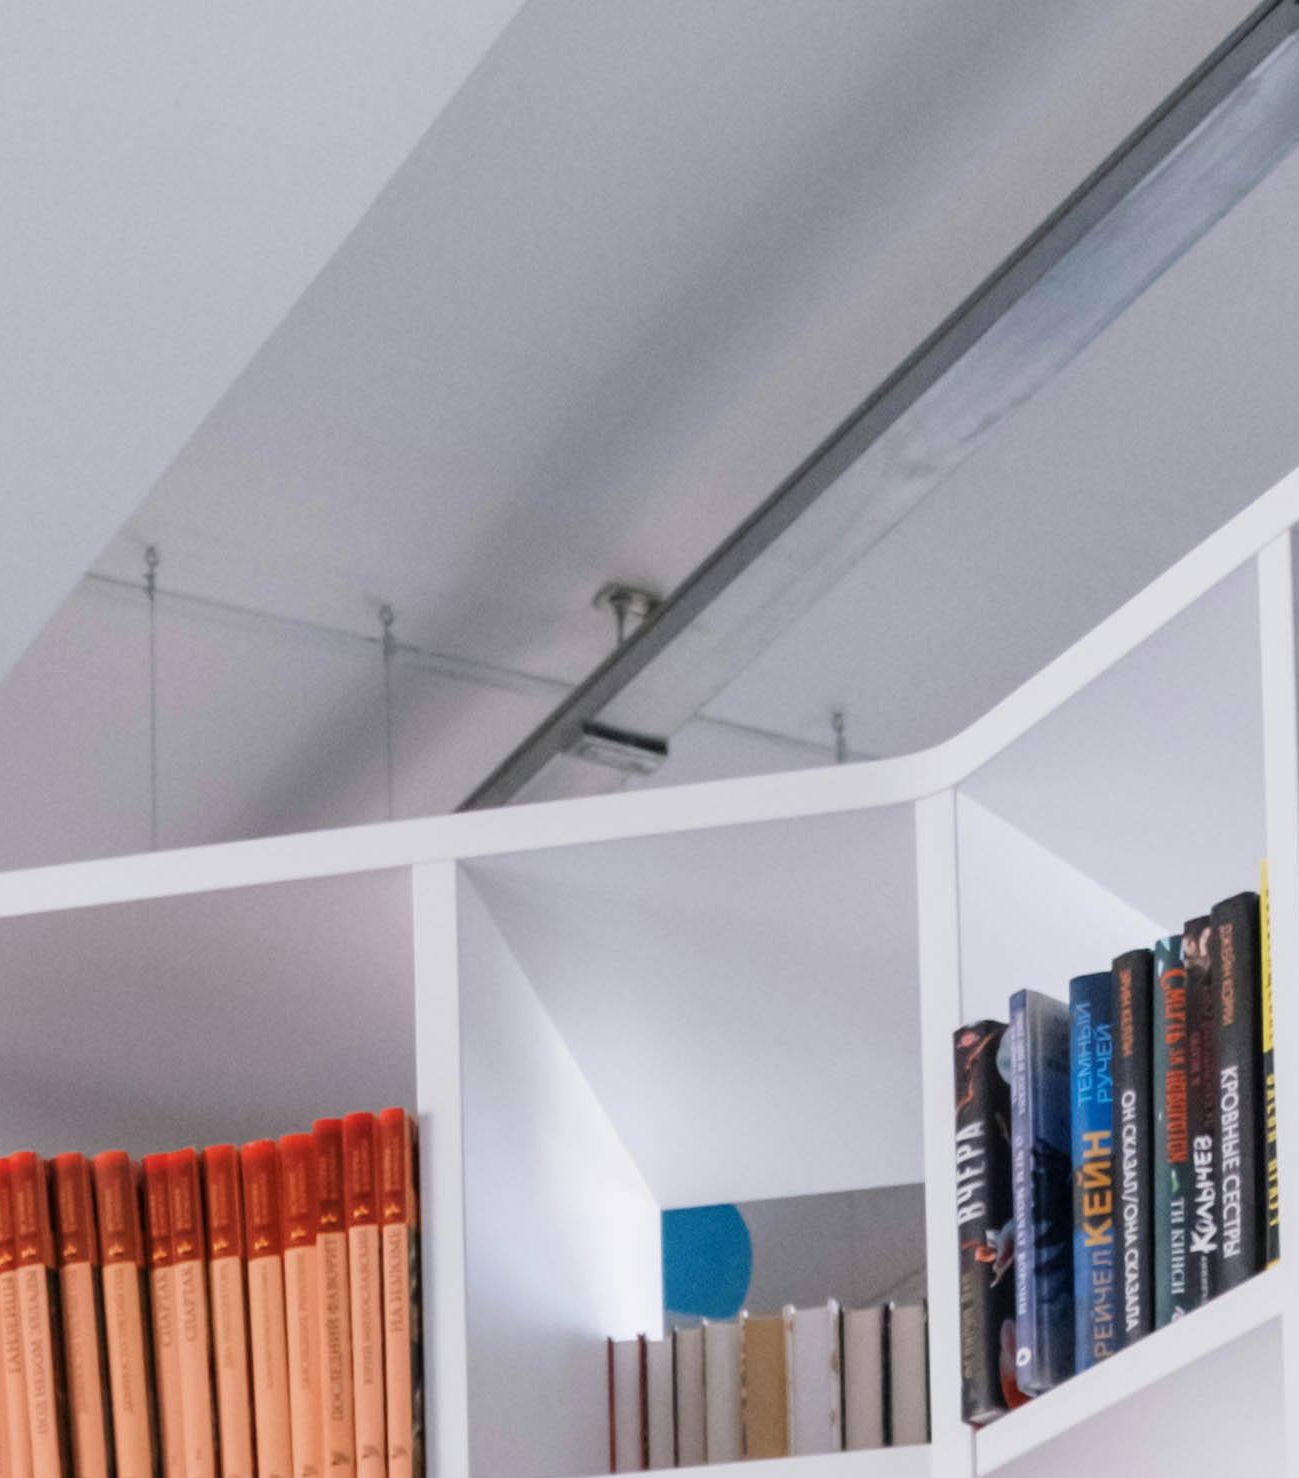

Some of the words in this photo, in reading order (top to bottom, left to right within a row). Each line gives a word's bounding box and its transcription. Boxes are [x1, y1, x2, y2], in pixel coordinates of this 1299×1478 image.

[1074, 1003, 1095, 1106] ТЕМНЫЙ
[1095, 1024, 1115, 1104] РУЧЕЙ
[1120, 1089, 1137, 1118] ОН
[1220, 1066, 1242, 1169] КРОВНЫЕ
[955, 1119, 988, 1229] ВЧЕРА
[1075, 1130, 1114, 1247] КЕЙН
[1220, 1176, 1242, 1260] СЕСТРЫ
[320, 1237, 343, 1315] ФАВОРИТ
[1092, 1249, 1115, 1358] РЕЙЧЕЛ
[1122, 1250, 1142, 1333] СКАЗАЛА
[323, 1319, 346, 1423] ПОСЛЕДНИЙ
